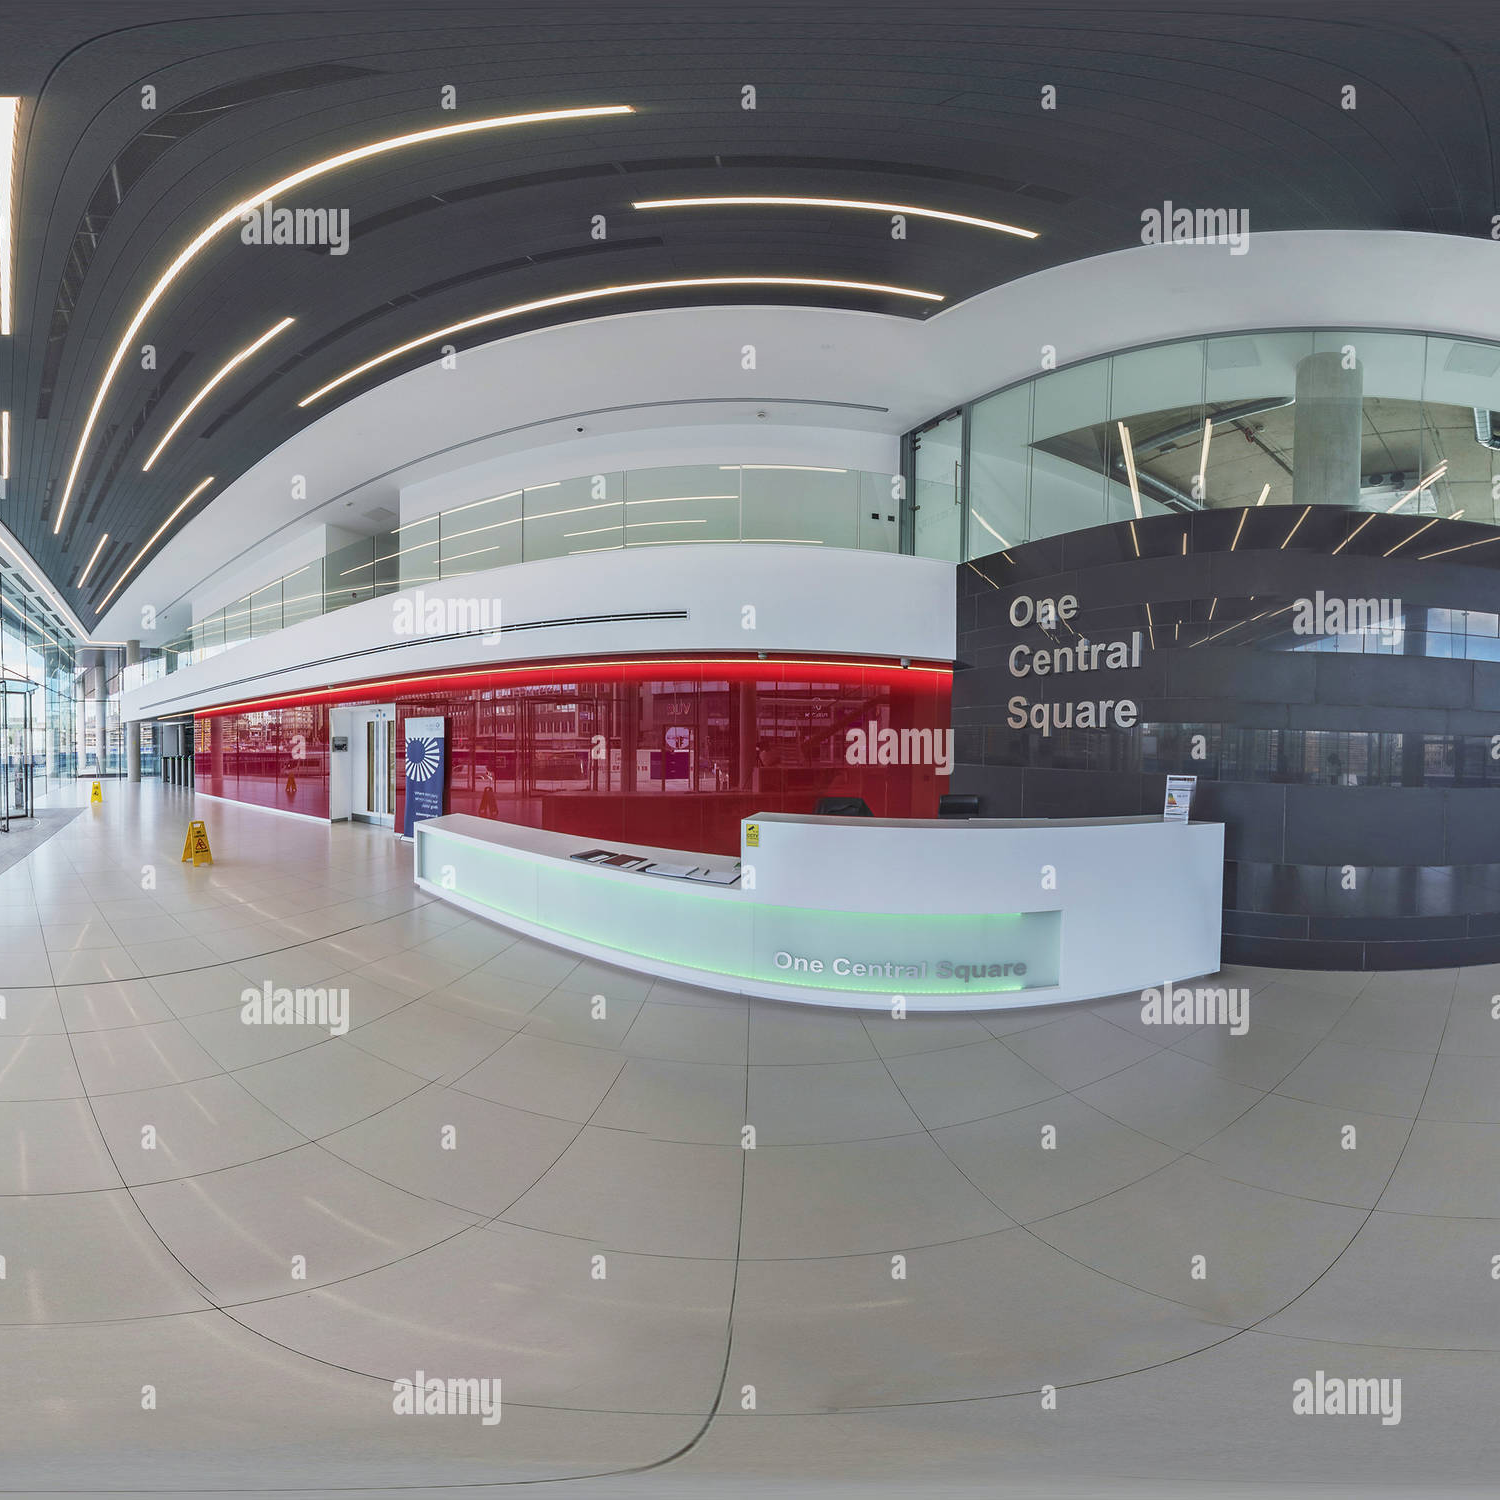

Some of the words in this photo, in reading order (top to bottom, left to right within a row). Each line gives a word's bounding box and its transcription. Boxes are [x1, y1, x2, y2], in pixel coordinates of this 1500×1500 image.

[1009, 595, 1078, 628] One
[1008, 631, 1142, 678] Central
[1007, 696, 1137, 737] Square
[773, 951, 824, 973] One
[832, 957, 927, 980] Central
[935, 960, 1028, 983] Square
